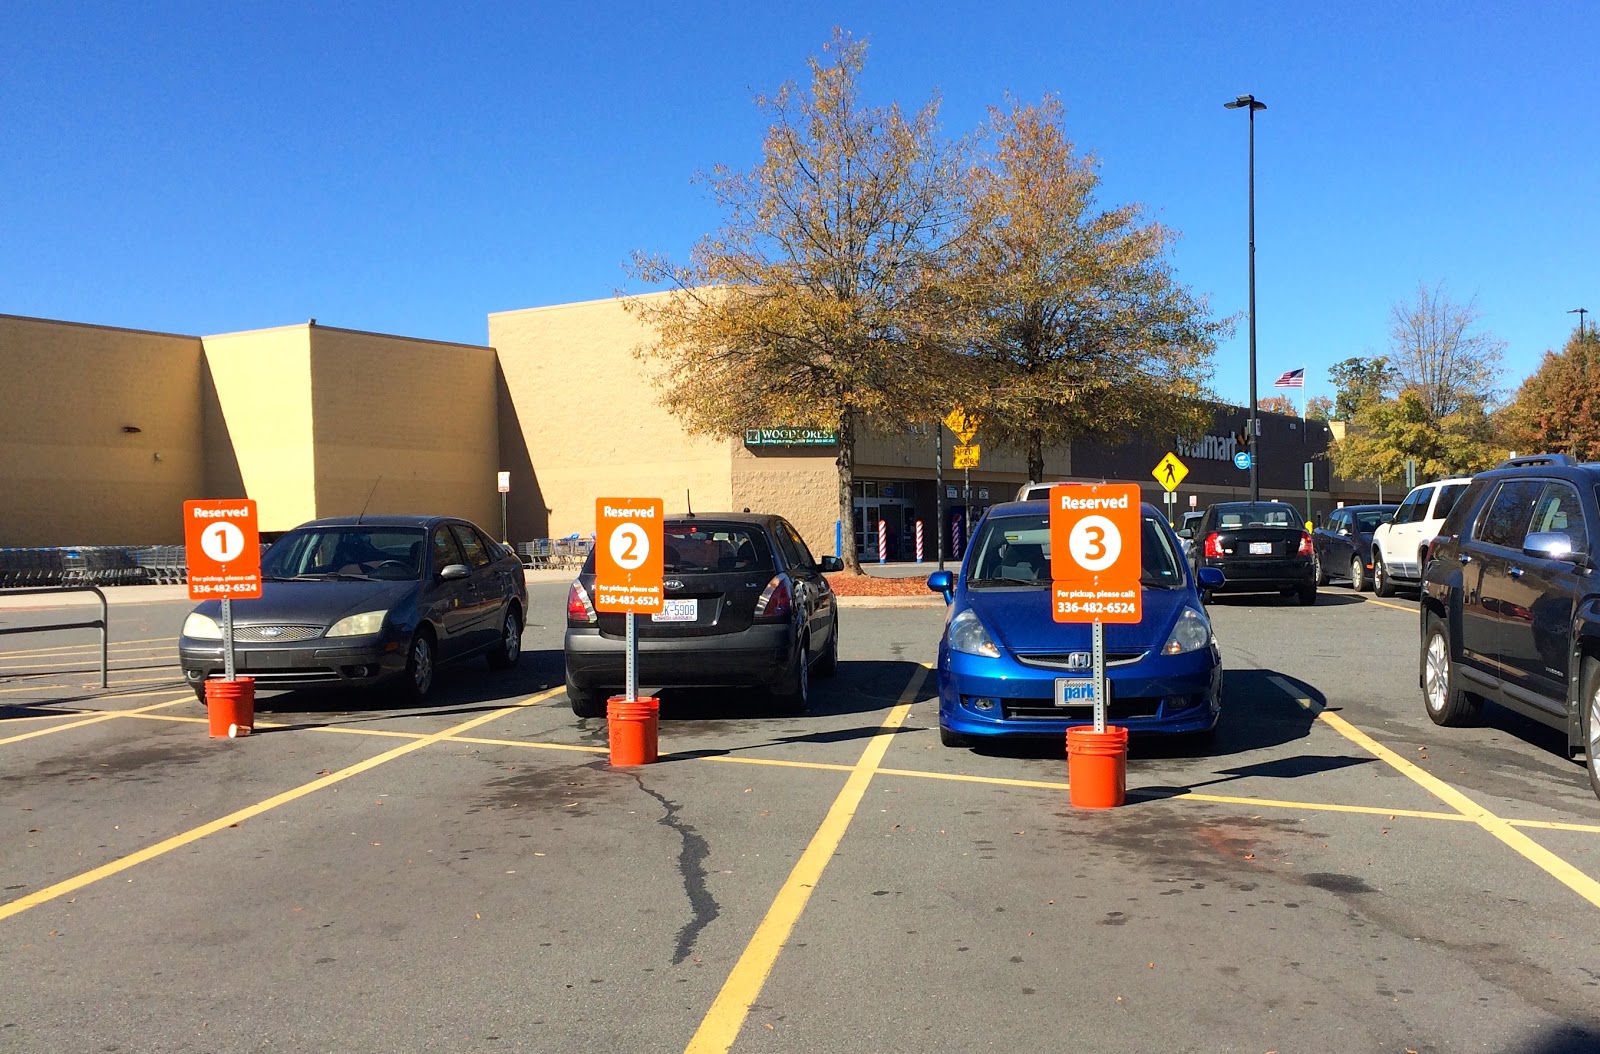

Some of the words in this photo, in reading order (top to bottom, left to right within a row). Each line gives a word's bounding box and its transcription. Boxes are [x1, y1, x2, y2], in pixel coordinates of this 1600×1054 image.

[1061, 494, 1128, 510] Reserved
[194, 507, 248, 518] Reserved
[604, 506, 655, 518] Reserved
[215, 529, 227, 554] 1
[621, 531, 638, 560] 2
[1084, 526, 1107, 561] 3
[192, 583, 257, 593] 336-482-6524
[609, 585, 630, 593] pickup,
[630, 585, 648, 593] please
[599, 594, 660, 606] 336-482-6524
[1057, 590, 1069, 598] For
[1069, 590, 1096, 599] pickup,
[1096, 590, 1120, 599] please
[1120, 590, 1136, 598] call:
[655, 604, 695, 616] K-5908
[1057, 601, 1136, 614] 336-482-6524
